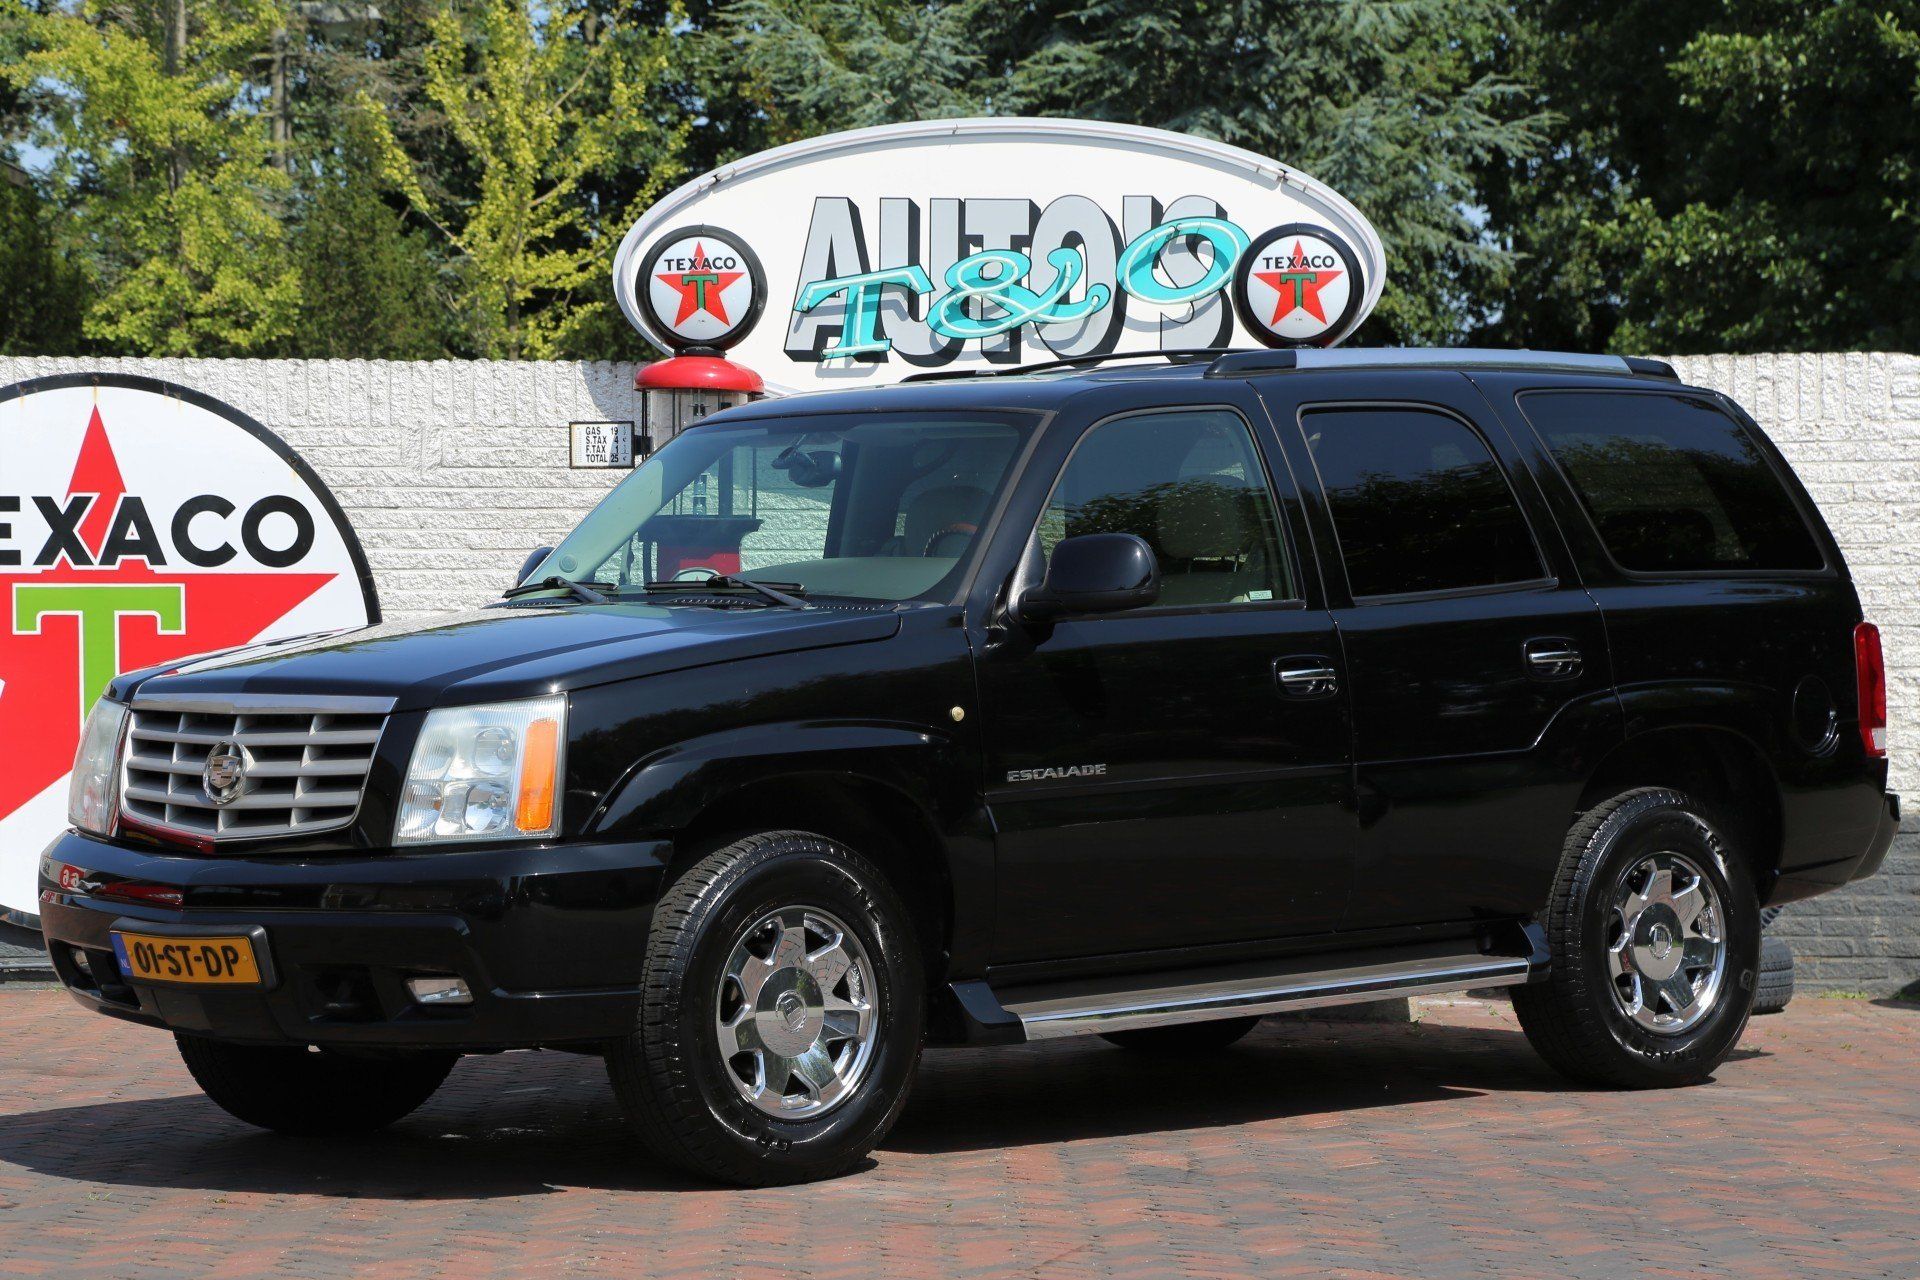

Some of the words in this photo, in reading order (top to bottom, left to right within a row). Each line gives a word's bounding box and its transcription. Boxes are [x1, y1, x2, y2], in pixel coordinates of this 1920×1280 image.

[664, 257, 737, 271] TEXACO
[1263, 255, 1336, 269] TEXACO
[682, 274, 719, 310] T
[1280, 272, 1317, 308] T
[586, 427, 601, 435] GAS
[611, 427, 619, 435] 19
[586, 436, 607, 444] S.TAX
[614, 436, 619, 444] 4
[586, 445, 606, 453] F.TAX
[586, 454, 607, 462] TOTAL
[611, 454, 619, 462] 25
[15, 585, 184, 724] T
[1007, 763, 1107, 782] ESCALADE
[120, 959, 131, 969] NL
[133, 941, 239, 977] 01-ST-DP
